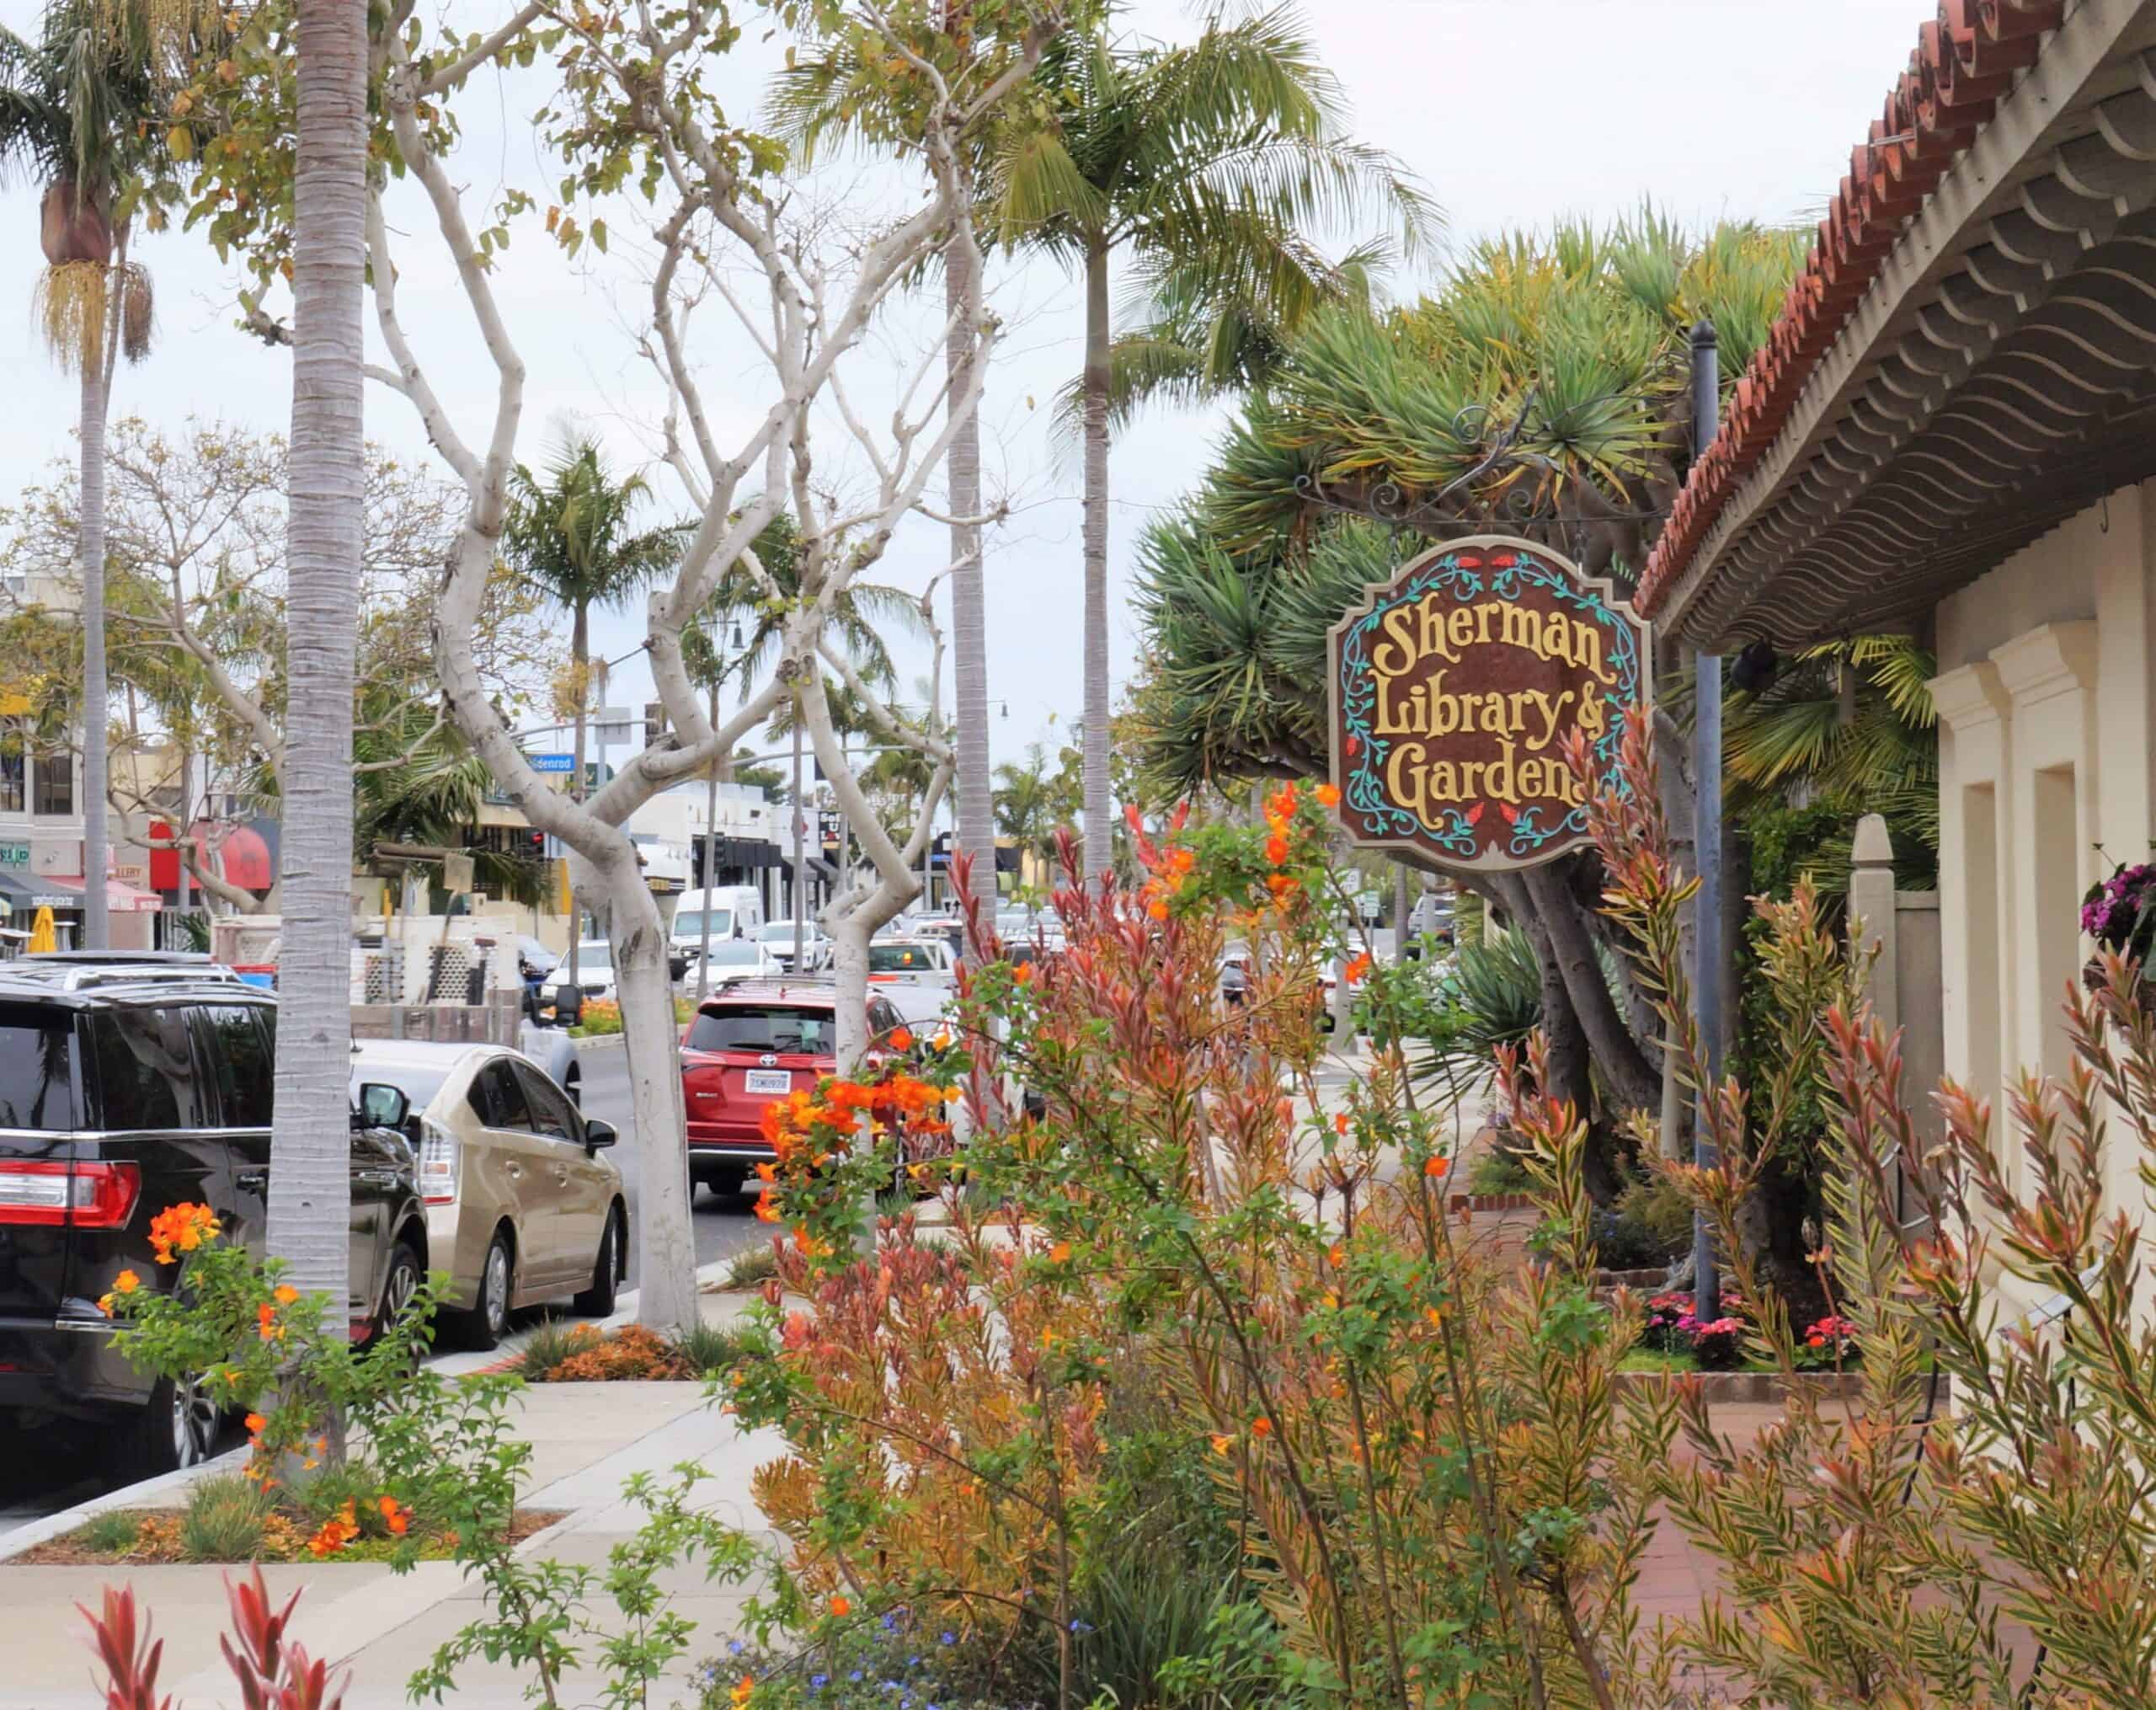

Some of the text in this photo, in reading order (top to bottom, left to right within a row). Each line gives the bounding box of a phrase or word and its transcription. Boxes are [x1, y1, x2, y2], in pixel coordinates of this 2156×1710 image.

[1373, 591, 1617, 685] Sherman
[1368, 669, 1606, 751] Library &
